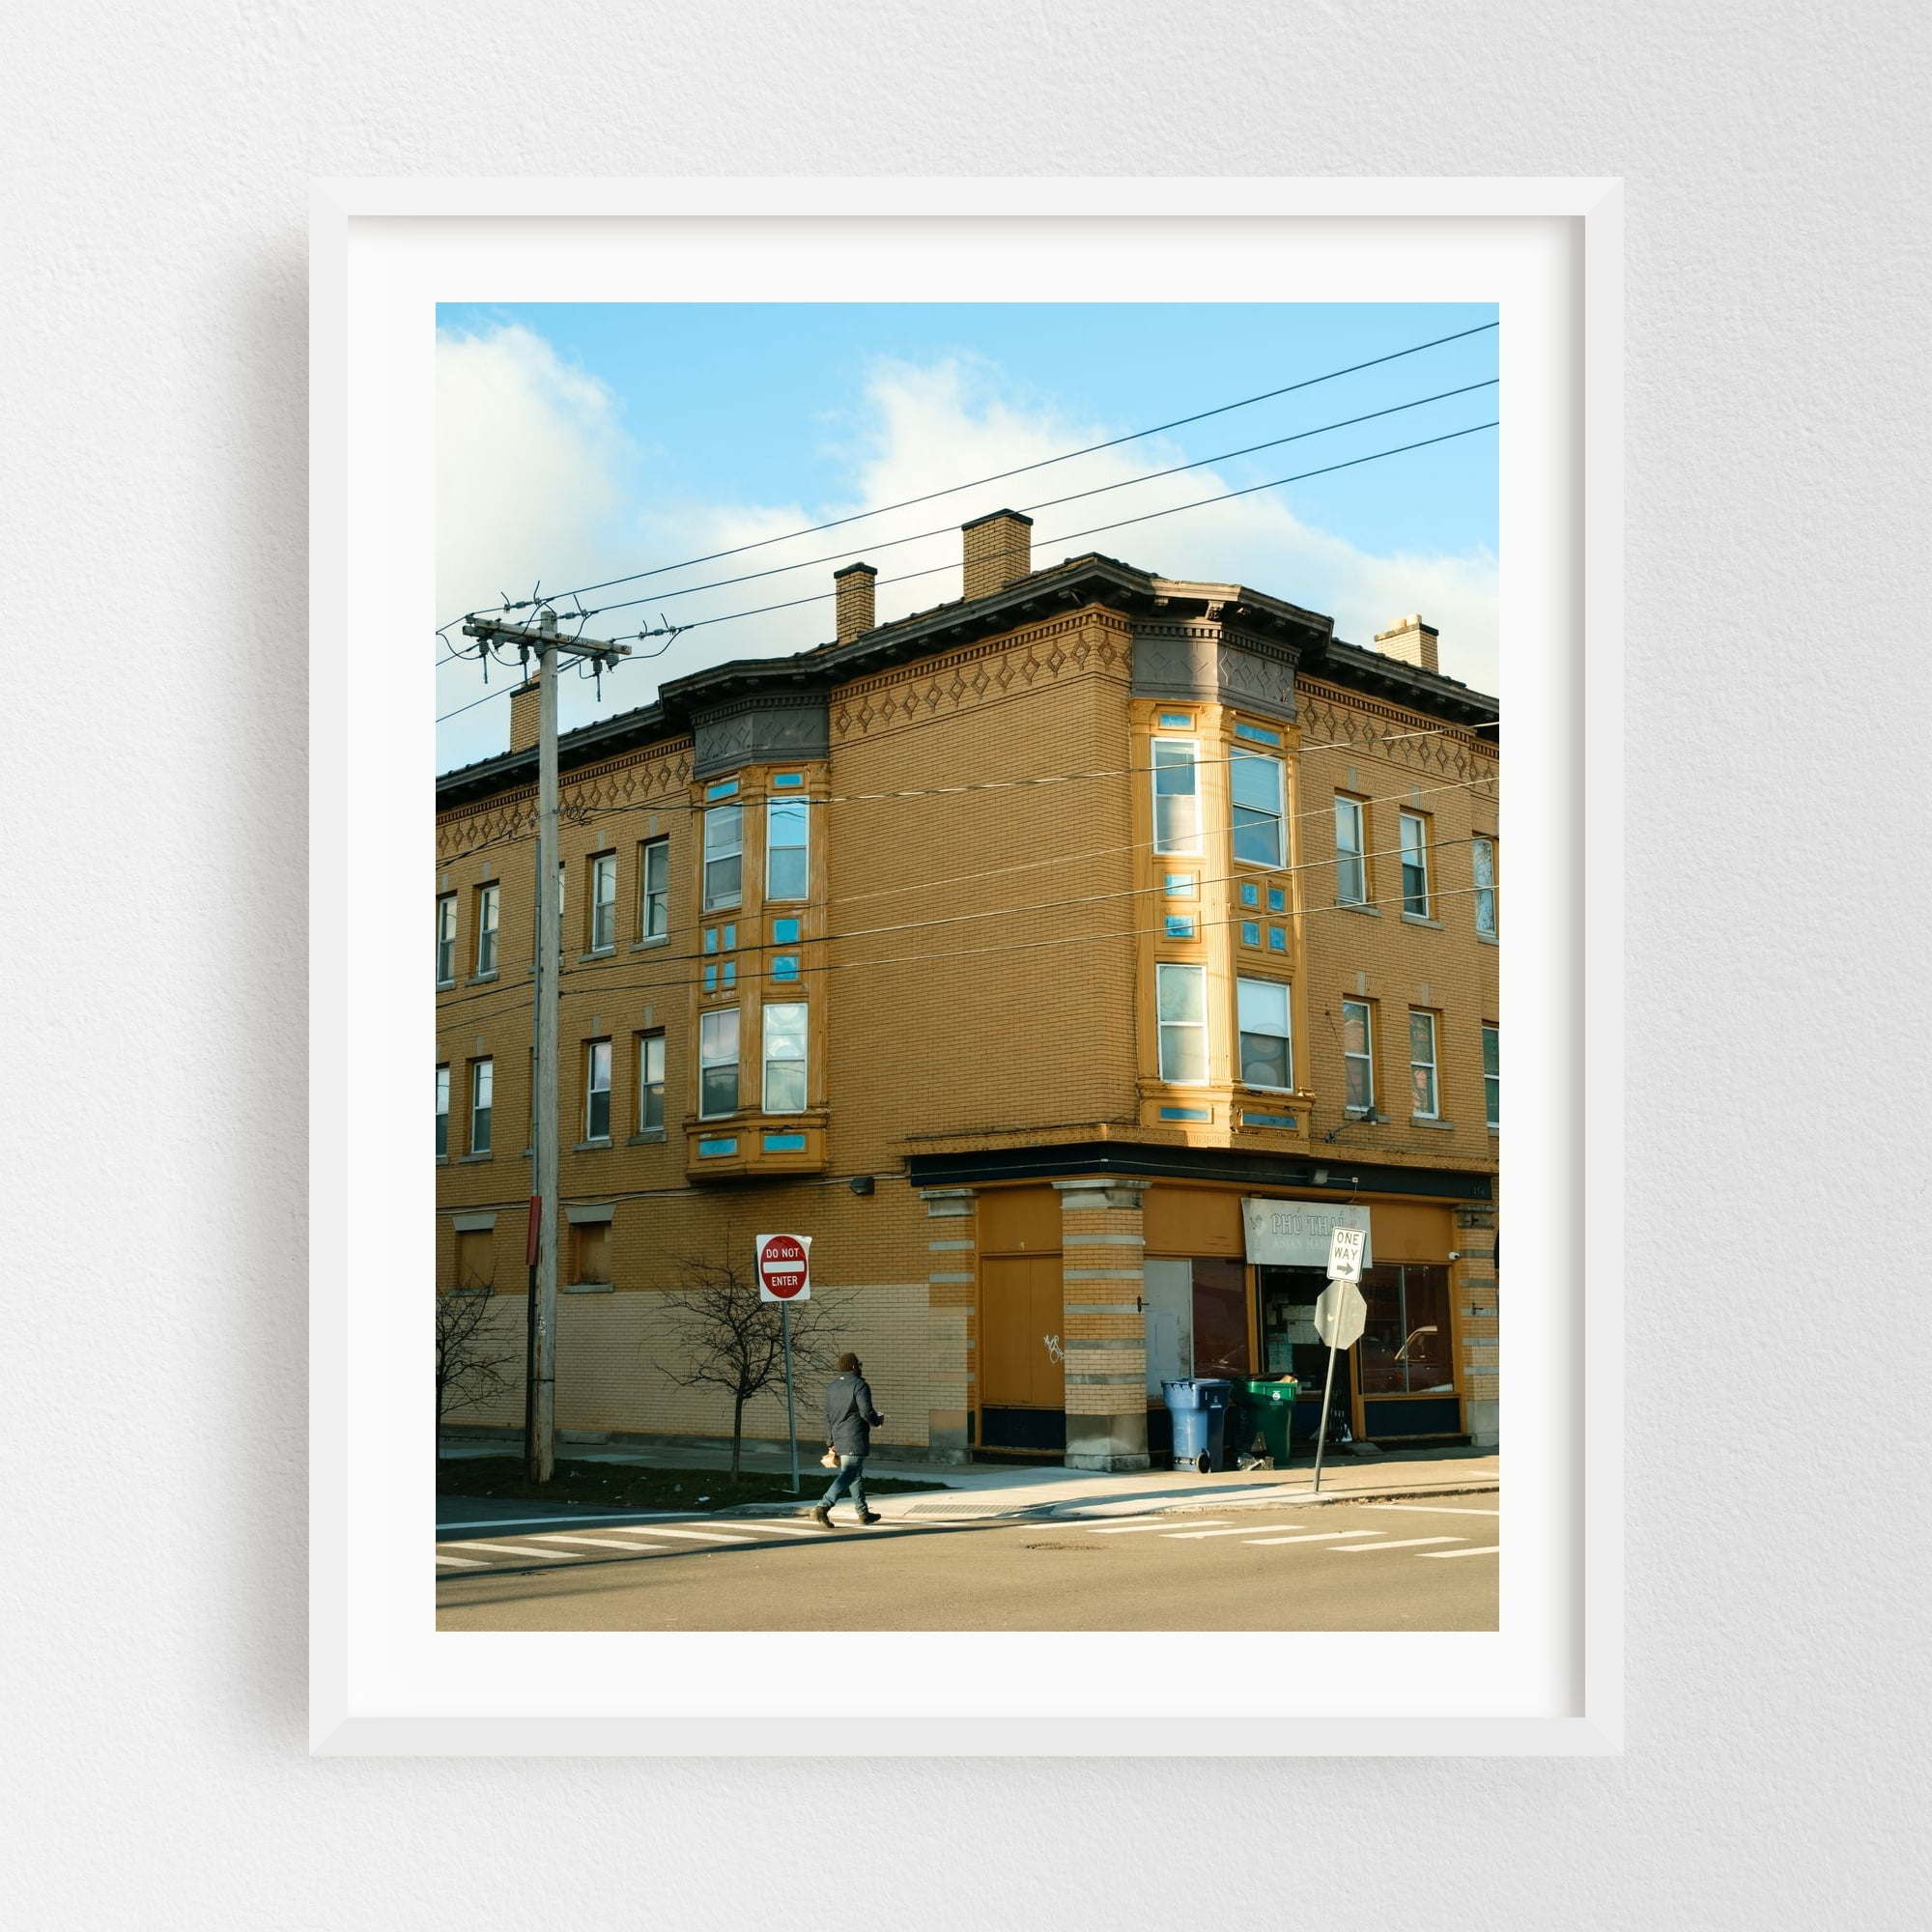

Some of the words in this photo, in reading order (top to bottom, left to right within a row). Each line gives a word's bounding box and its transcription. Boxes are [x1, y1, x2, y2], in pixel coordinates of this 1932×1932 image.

[1337, 1232, 1360, 1246] ONE
[766, 1248, 779, 1258] DO
[781, 1247, 800, 1258] NOT
[1335, 1247, 1358, 1261] WAY
[772, 1276, 798, 1287] ENTER
